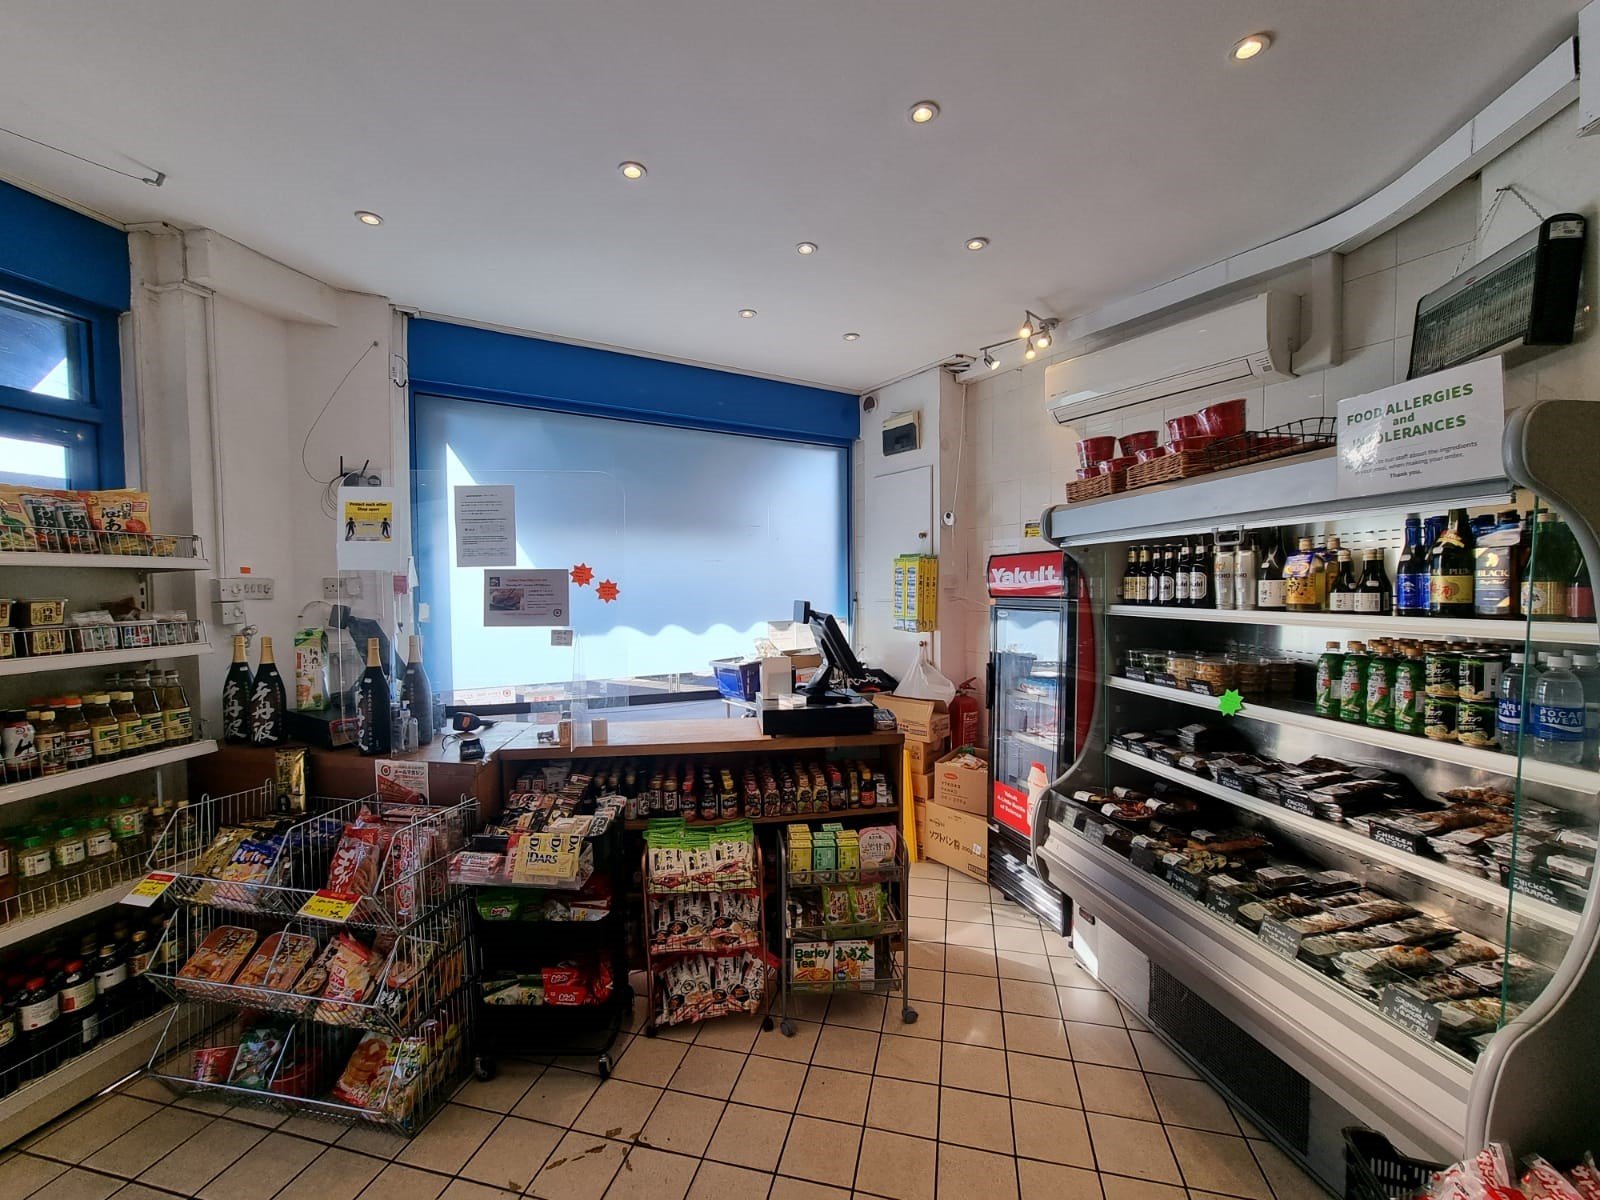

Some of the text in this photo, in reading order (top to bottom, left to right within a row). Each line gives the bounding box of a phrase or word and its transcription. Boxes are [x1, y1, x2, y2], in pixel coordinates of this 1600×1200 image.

[1347, 383, 1474, 426] FOOD ALLERGIES
[1393, 412, 1415, 426] and
[1409, 450, 1427, 459] about
[1429, 448, 1438, 456] the
[1439, 441, 1478, 454] ingredients
[1406, 459, 1428, 468] making
[1429, 456, 1443, 464] your
[992, 566, 1056, 585] Yakult
[1477, 569, 1510, 577] BLACK
[1374, 834, 1414, 853] TATSUTA
[1376, 830, 1413, 846] CHICKEN
[529, 852, 558, 865] DARS
[795, 947, 830, 960] Barley
[836, 946, 873, 962] むぎ茶
[795, 959, 816, 968] Tea
